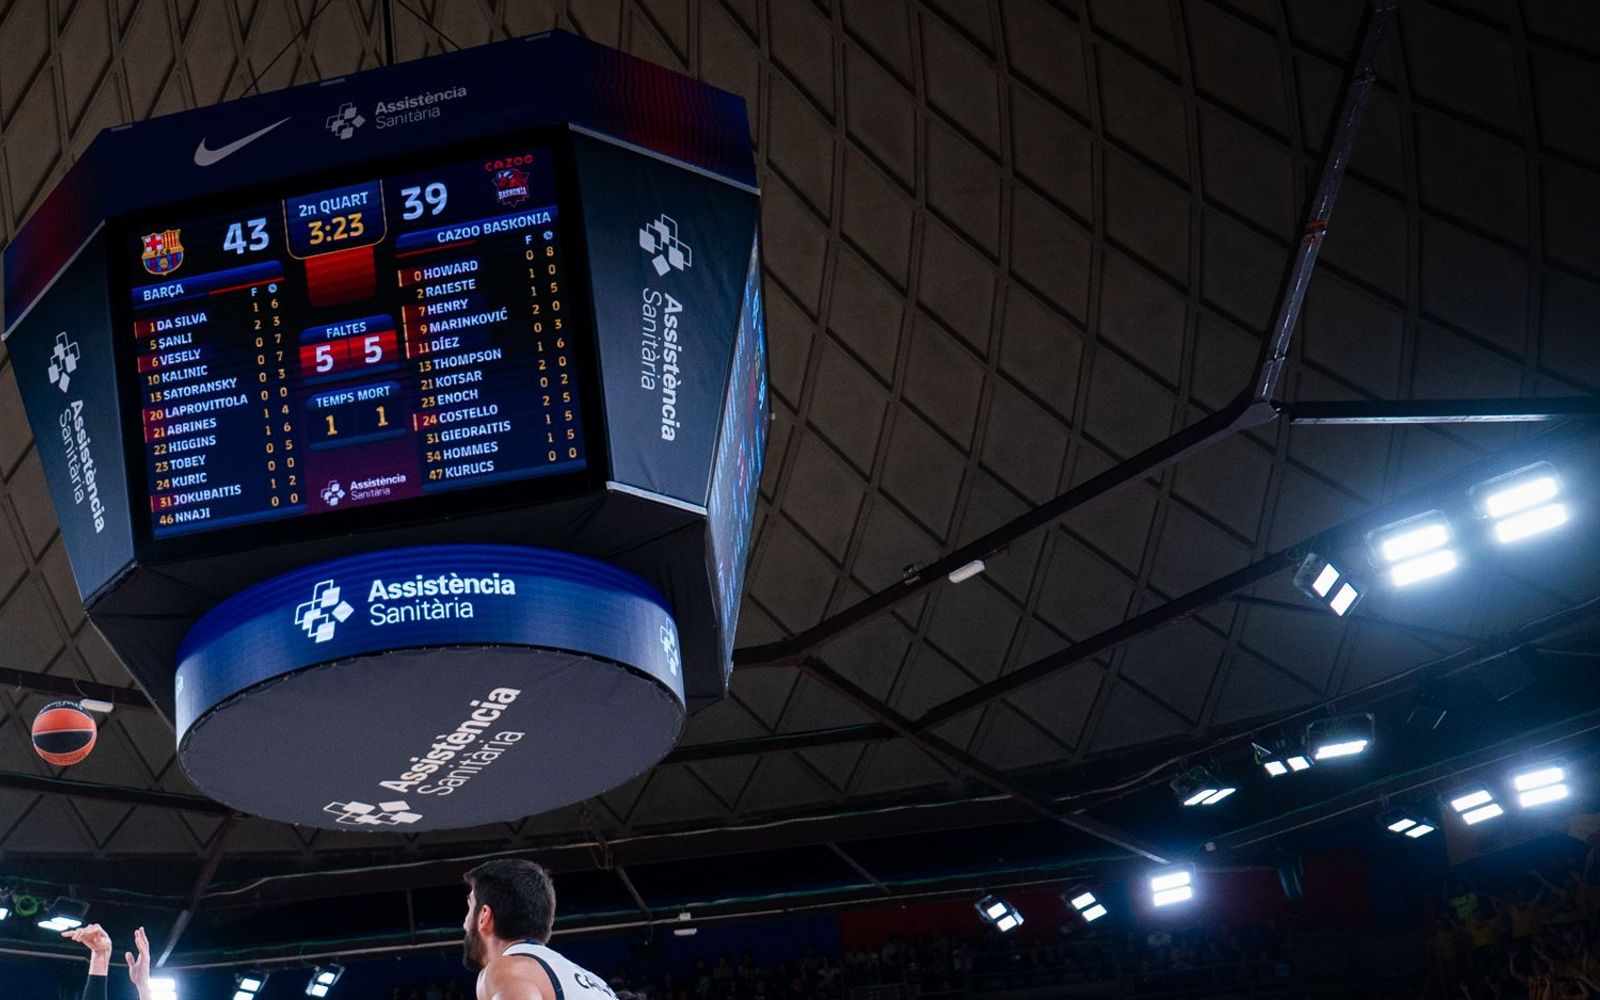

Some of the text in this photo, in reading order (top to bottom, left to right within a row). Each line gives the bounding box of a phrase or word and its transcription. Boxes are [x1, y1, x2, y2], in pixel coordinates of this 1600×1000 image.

[374, 85, 468, 116] Assistència
[375, 105, 441, 130] Sanitària
[484, 154, 533, 171] CAZOO
[298, 191, 369, 218] 2n QUART
[400, 183, 448, 220] 39
[222, 218, 270, 255] 43
[309, 213, 365, 245] 3:23
[437, 212, 551, 243] CAZOO BASKONIA
[525, 235, 532, 245] F
[414, 247, 554, 281] 0 HOWARD 8
[143, 284, 184, 301] BARÇA
[251, 287, 258, 297] F
[417, 265, 556, 299] 2 RAIESTE 1 0
[150, 299, 278, 332] 1 DA SILVA 1 6
[419, 283, 558, 316] 7 HENRY 1 5
[150, 317, 280, 350] 5 ŞANLI 2 3
[326, 322, 367, 338] FALTES
[420, 301, 560, 335] 9 MARINKOVIĆ 2 0
[152, 334, 282, 367] 6 VESELY 7
[418, 319, 562, 353] 11 DÍEZ 3
[641, 288, 662, 391] Sanitària
[148, 352, 283, 385] 10 KALINIC 7
[316, 336, 383, 372] 5 5
[419, 338, 564, 372] 13 THOMPSON 1 6
[661, 293, 684, 441] Assistència
[150, 369, 285, 402] 13 SATORANSKY 3
[421, 356, 566, 391] 21 KOTSAR 2 0
[150, 387, 288, 421] 20 LAPROVITTOLA 0
[316, 386, 391, 408] TEMPS MORT
[421, 374, 568, 408] 23 ENOCH 2
[153, 405, 289, 438] 21 ABRINES 1 4
[326, 406, 388, 435] 1 1
[423, 392, 570, 426] 24 COSTELLO 2 5
[154, 422, 291, 455] 22 HIGGINS 1 6
[426, 411, 572, 444] 31 GIEDRAITIS 1 5
[60, 409, 84, 504] Sanitària
[155, 440, 292, 472] 23 TOBEY 5
[426, 429, 575, 463] 34 HOMMES 1 5
[71, 400, 105, 533] Assistència
[156, 458, 294, 490] 24 KURIC 0
[429, 448, 577, 480] 47 KURUCS 0
[160, 476, 296, 508] 31 JOKUBAITIS 1 2
[350, 474, 407, 490] Assistència
[159, 493, 298, 525] 46 NNAJI 0
[368, 573, 516, 602] Assistència
[370, 599, 474, 626] Sanitària
[379, 686, 522, 794] Assistència
[417, 731, 525, 797] Sanitària
